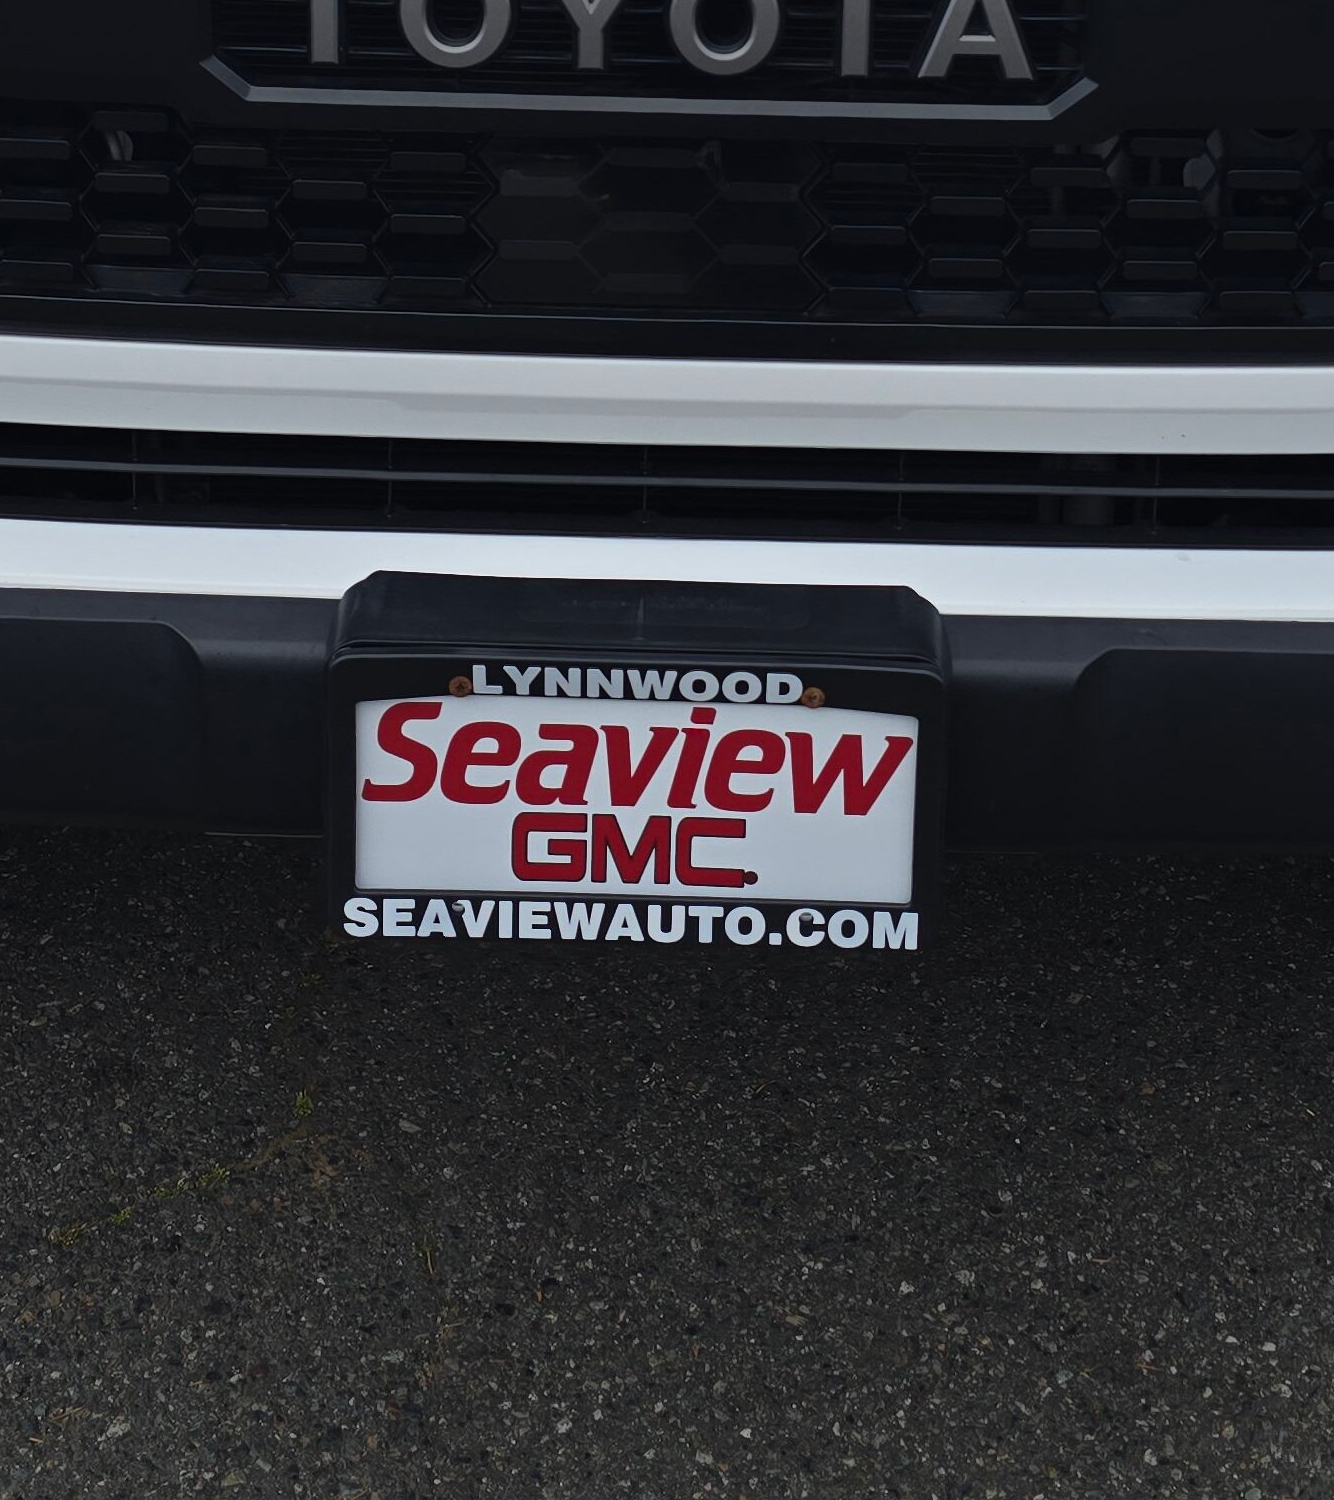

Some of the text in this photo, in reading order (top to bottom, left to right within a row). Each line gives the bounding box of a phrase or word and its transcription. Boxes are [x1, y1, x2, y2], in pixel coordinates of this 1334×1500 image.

[470, 664, 805, 705] LYNNWOOD
[360, 701, 915, 817] Seaview
[510, 811, 748, 889] GMC
[342, 897, 919, 952] SEAVIEWAUTO.COM
